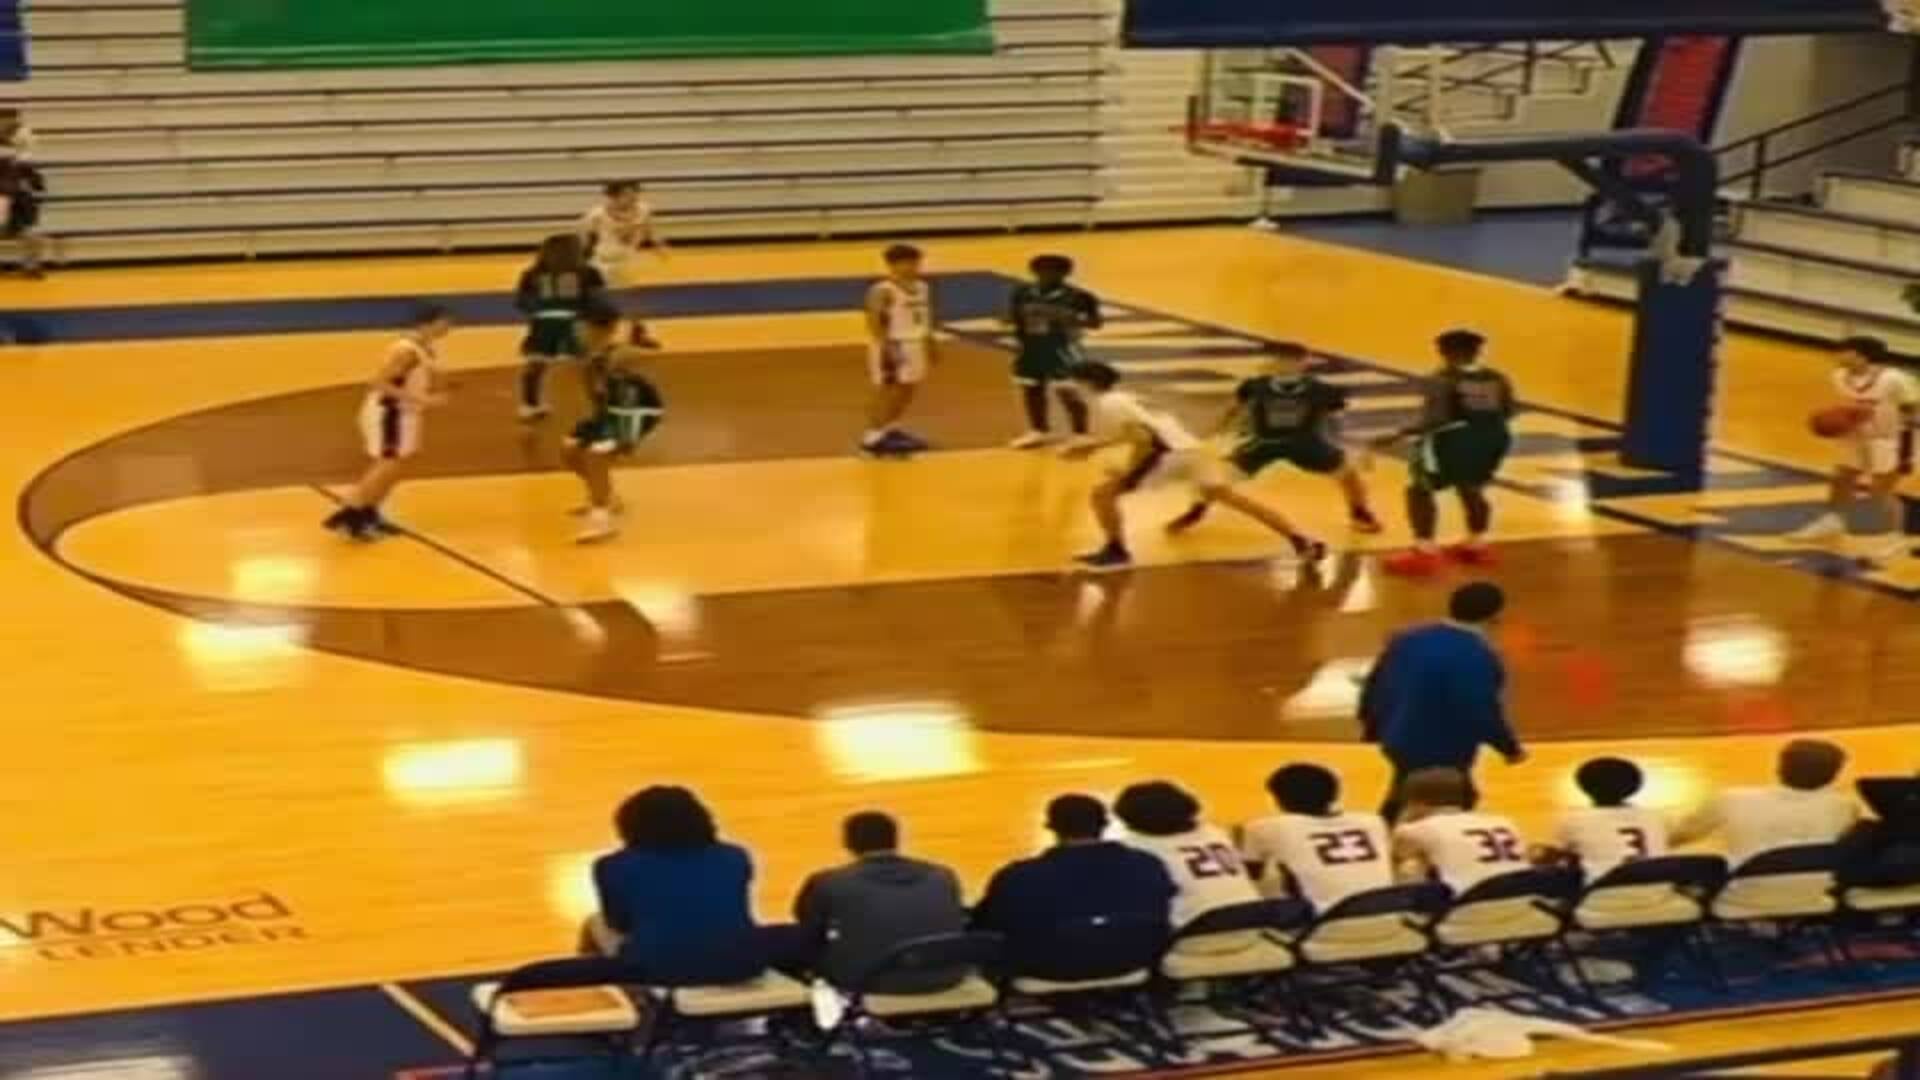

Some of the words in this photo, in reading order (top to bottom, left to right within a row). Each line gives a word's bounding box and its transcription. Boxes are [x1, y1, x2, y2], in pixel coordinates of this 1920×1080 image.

[1308, 828, 1379, 865] 23
[1462, 827, 1521, 862] 32
[1617, 826, 1649, 862] 3
[0, 891, 291, 939] Wood
